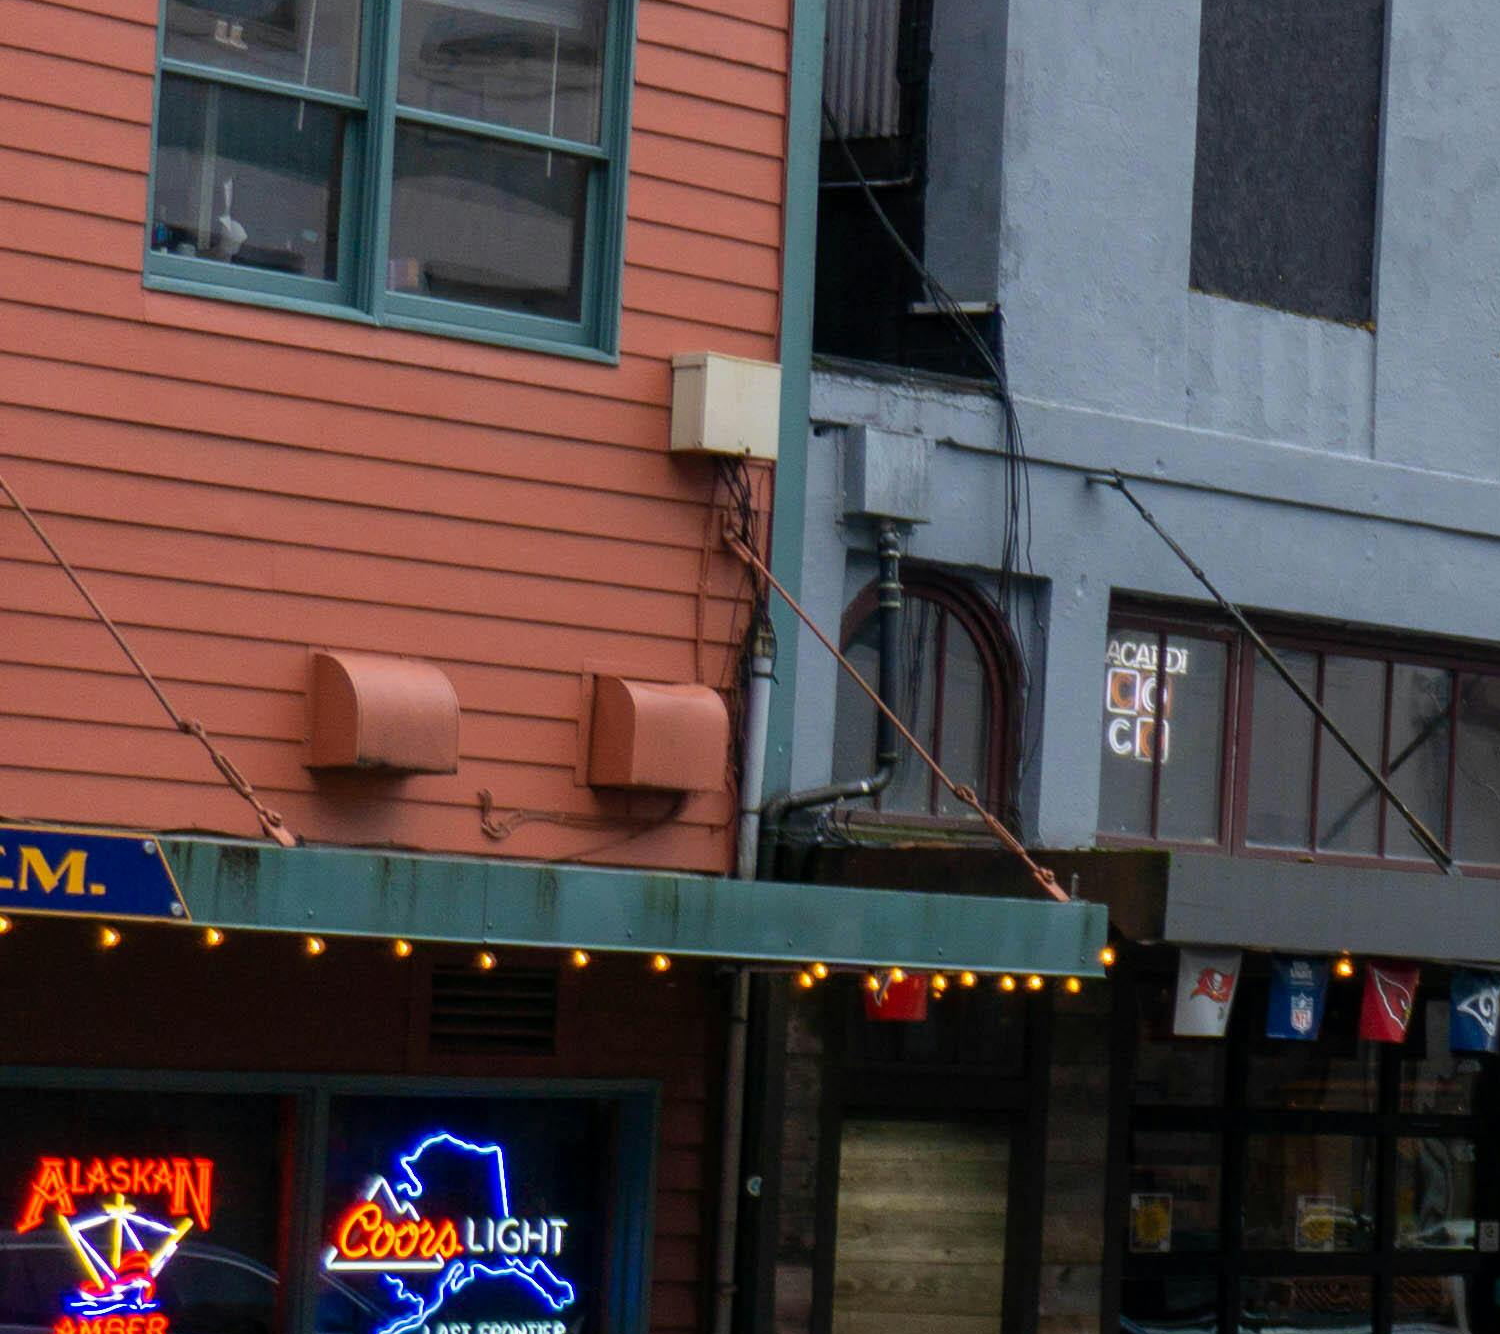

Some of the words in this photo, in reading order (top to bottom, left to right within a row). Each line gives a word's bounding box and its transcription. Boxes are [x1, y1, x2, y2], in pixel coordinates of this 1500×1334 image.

[17, 1157, 214, 1233] ALASKAN
[338, 1201, 462, 1259] Coors
[465, 1218, 569, 1256] LIGHT
